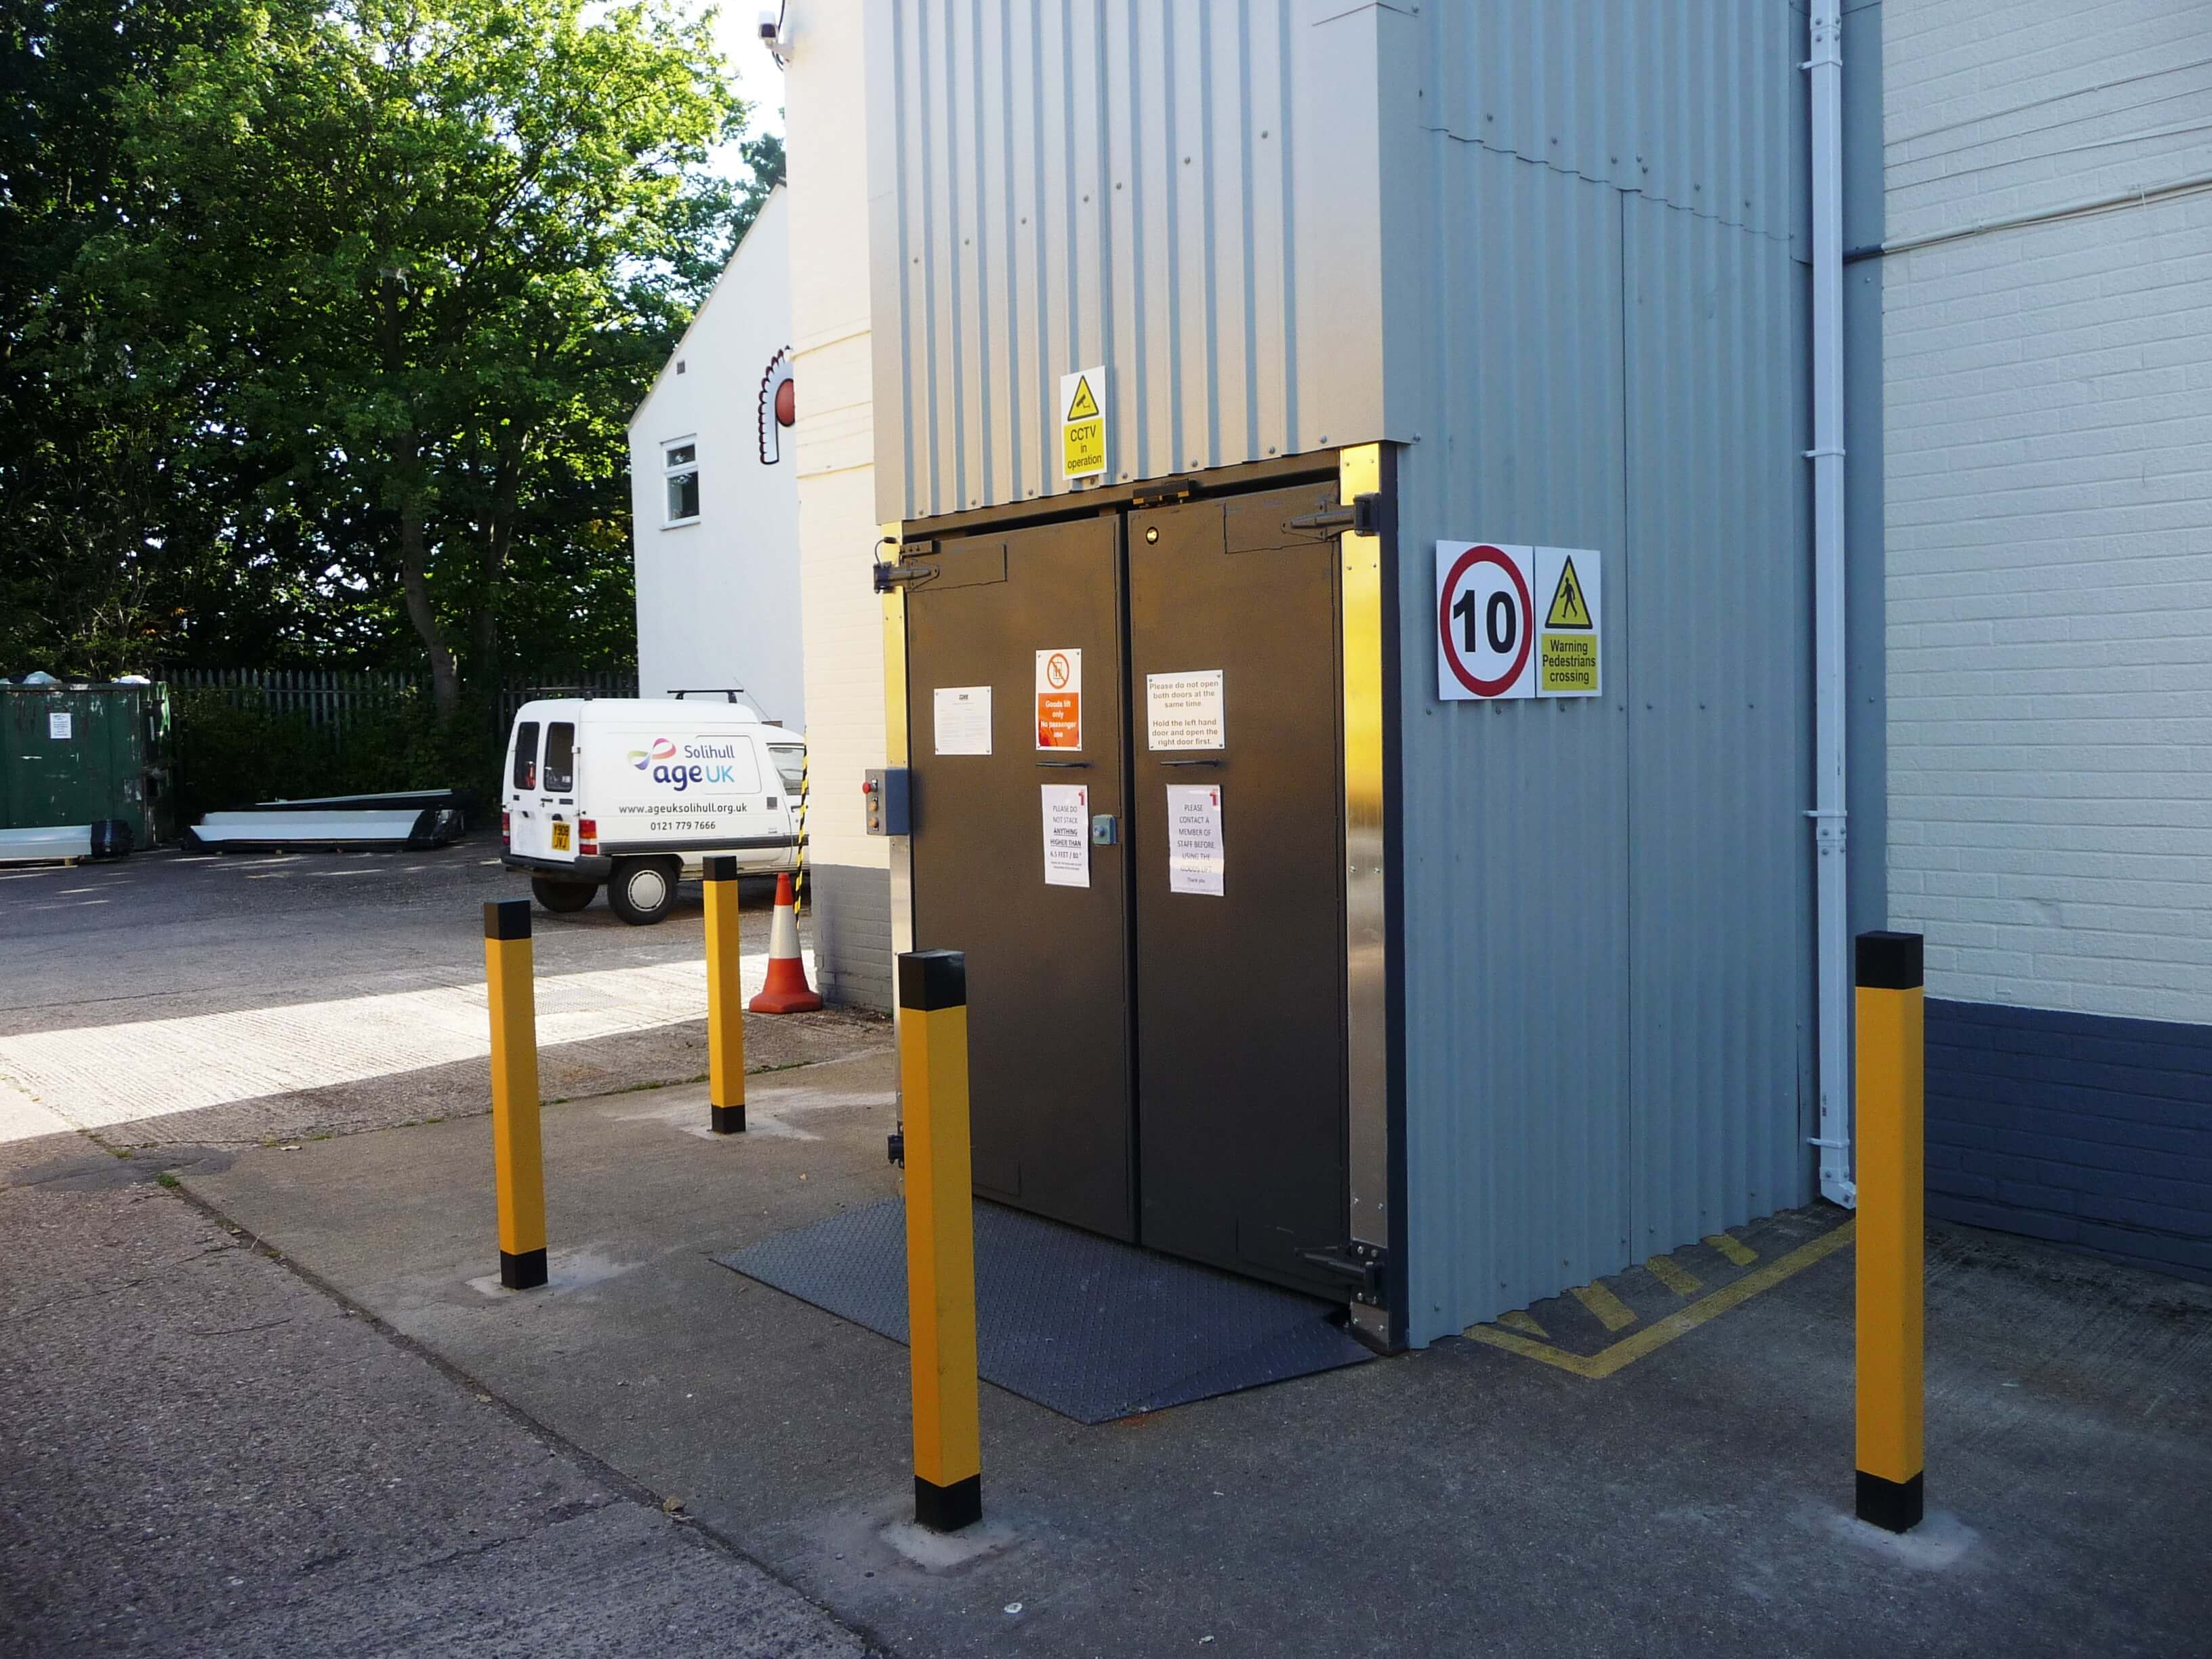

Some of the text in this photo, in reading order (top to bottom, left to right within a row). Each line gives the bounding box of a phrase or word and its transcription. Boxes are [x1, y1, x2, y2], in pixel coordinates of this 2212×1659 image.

[1070, 425, 1097, 442] CCTV
[1081, 443, 1087, 453] in
[1067, 454, 1101, 470] operation
[1454, 590, 1516, 653] 10
[1551, 639, 1588, 655] Warning
[1542, 655, 1596, 668] Pedestrians
[1550, 670, 1589, 684] crossing
[1052, 710, 1064, 719] only
[1048, 721, 1076, 729] passenger
[1158, 739, 1174, 747] right
[684, 745, 735, 758] Solihull
[653, 764, 735, 792] age UK
[619, 802, 747, 815] www.ageuksolihull.org.uk
[1184, 804, 1203, 812] PLEASE
[651, 821, 716, 830] 0121 779 7666
[1179, 816, 1204, 824] CONTACT
[1054, 827, 1078, 836] ANYTHING
[1177, 840, 1214, 848] STAFF BEFORE
